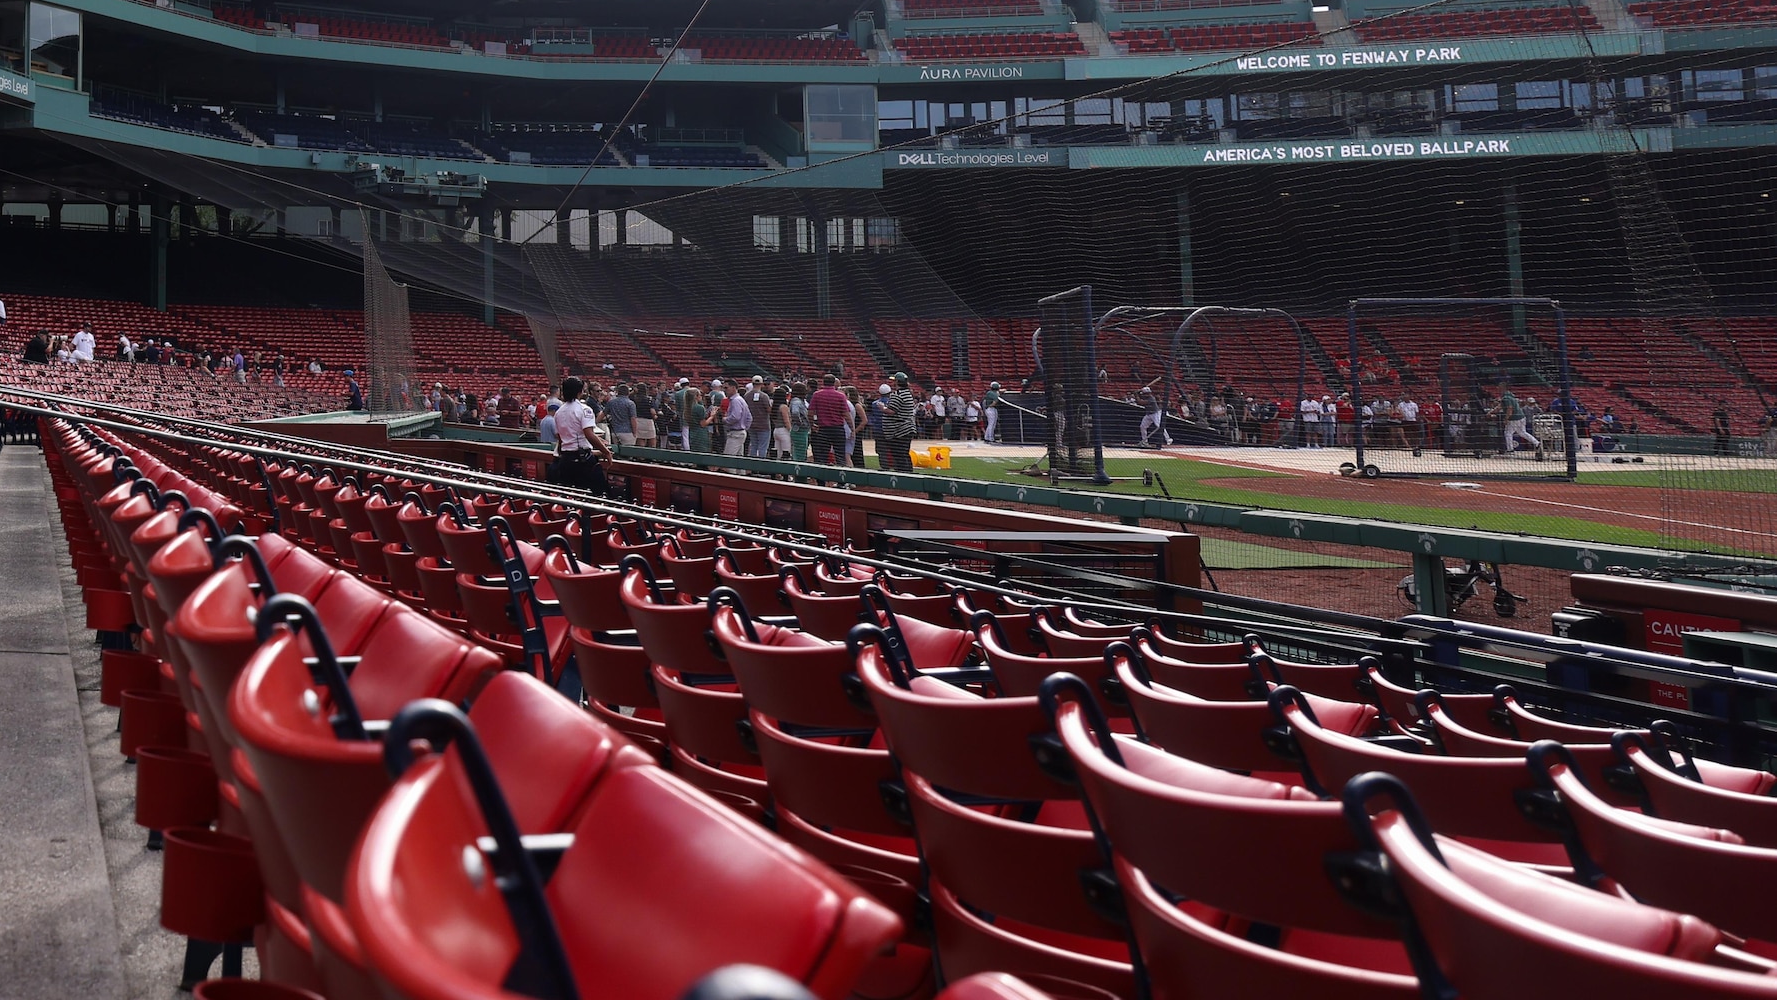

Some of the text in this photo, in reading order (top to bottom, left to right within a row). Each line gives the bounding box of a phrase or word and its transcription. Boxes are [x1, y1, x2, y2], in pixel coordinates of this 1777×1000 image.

[1237, 47, 1461, 70] WELCOME TO FENWAY PARK
[965, 66, 1022, 78] PAVILION
[13, 78, 28, 95] Level
[1017, 151, 1049, 163] Level
[1203, 139, 1510, 163] AMERICA'S MOST BELOVED BALLPARK
[819, 511, 840, 521] CAUTION!
[511, 570, 523, 582] D
[887, 636, 899, 649] C
[1657, 689, 1672, 698] THE
